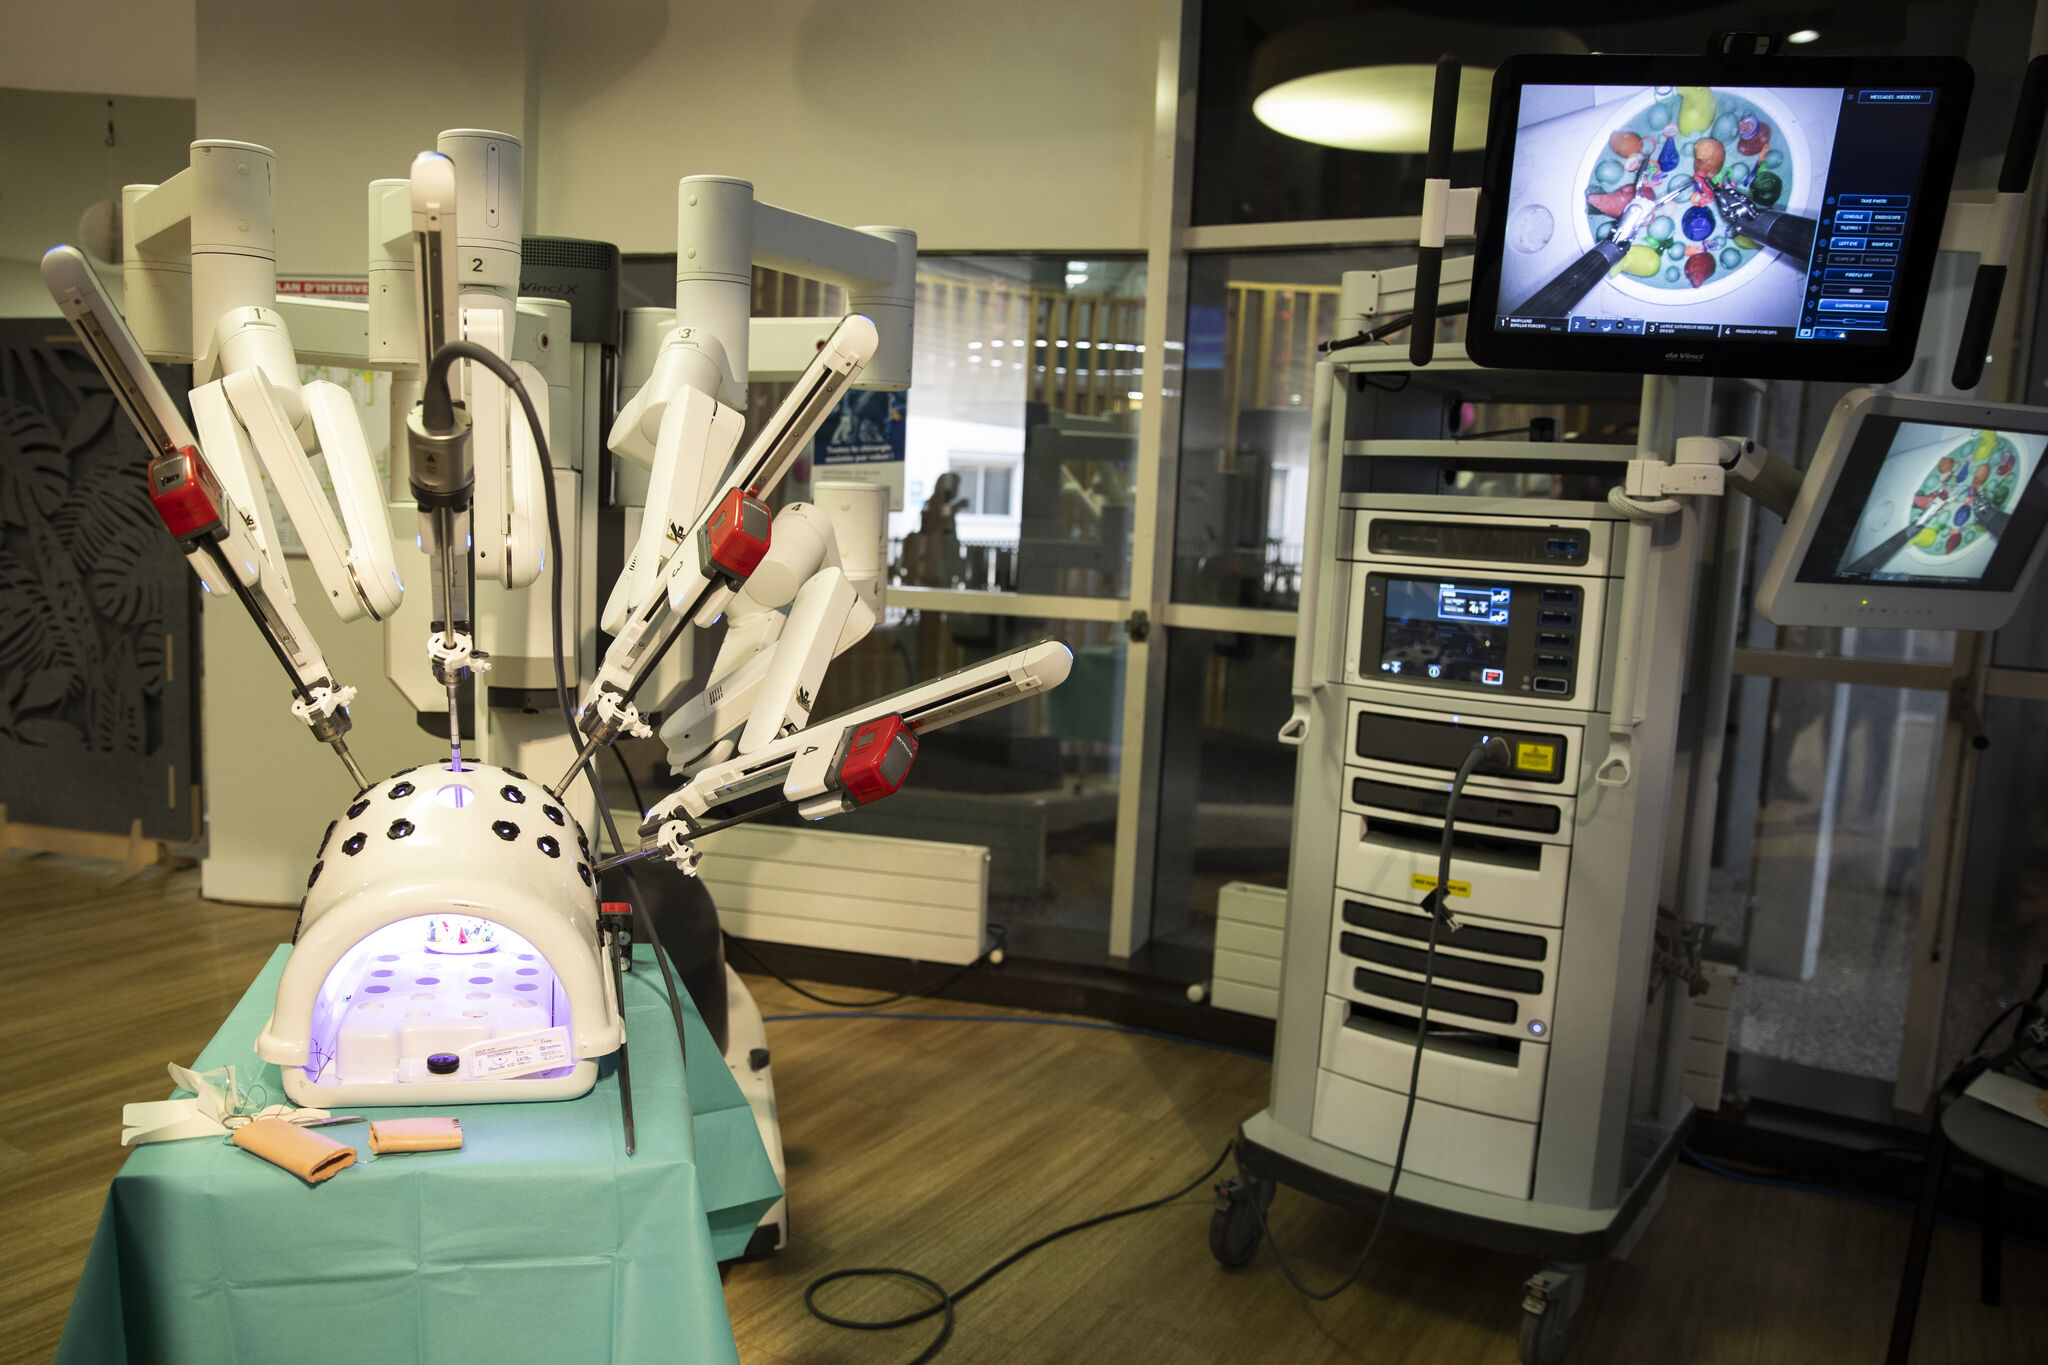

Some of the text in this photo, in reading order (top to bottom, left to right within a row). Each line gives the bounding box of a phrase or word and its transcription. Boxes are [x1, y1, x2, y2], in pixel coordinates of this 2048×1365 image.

[472, 258, 483, 272] 2
[277, 282, 369, 293] LAN D'INTERVE
[520, 282, 578, 295] Vinci X
[254, 308, 261, 319] 1
[1574, 321, 1580, 329] 2
[1649, 324, 1656, 333] 3
[680, 328, 691, 339] 3
[1724, 327, 1731, 335] 4
[1680, 352, 1704, 360] Vinci
[855, 455, 867, 463] par
[792, 503, 802, 512] 4
[672, 560, 683, 578] 3
[802, 746, 819, 756] 4
